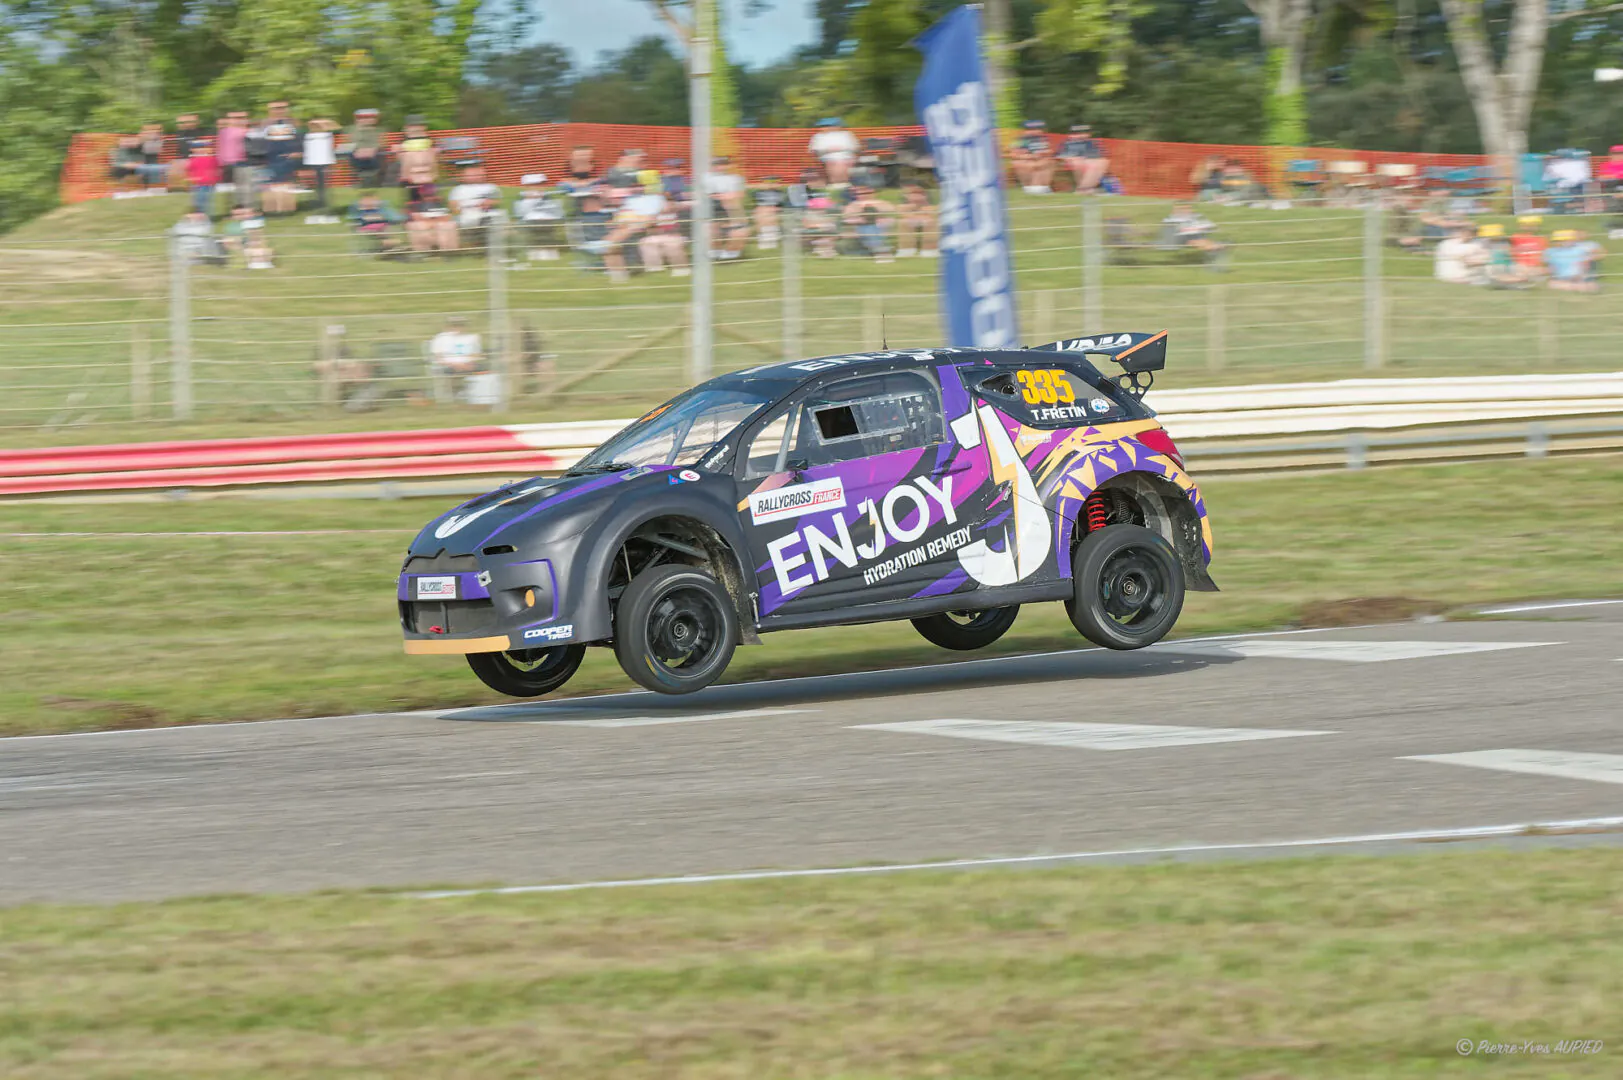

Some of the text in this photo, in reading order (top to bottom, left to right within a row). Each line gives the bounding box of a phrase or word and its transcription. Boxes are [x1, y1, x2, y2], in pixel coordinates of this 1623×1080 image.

[1016, 369, 1076, 404] 335
[1030, 406, 1087, 420] T.FRETIN
[757, 488, 841, 513] RALLYCROSS FRANCE
[767, 475, 958, 596] ENJOY
[863, 525, 972, 585] HYDRATION REMEDY
[524, 624, 573, 639] COOPER
